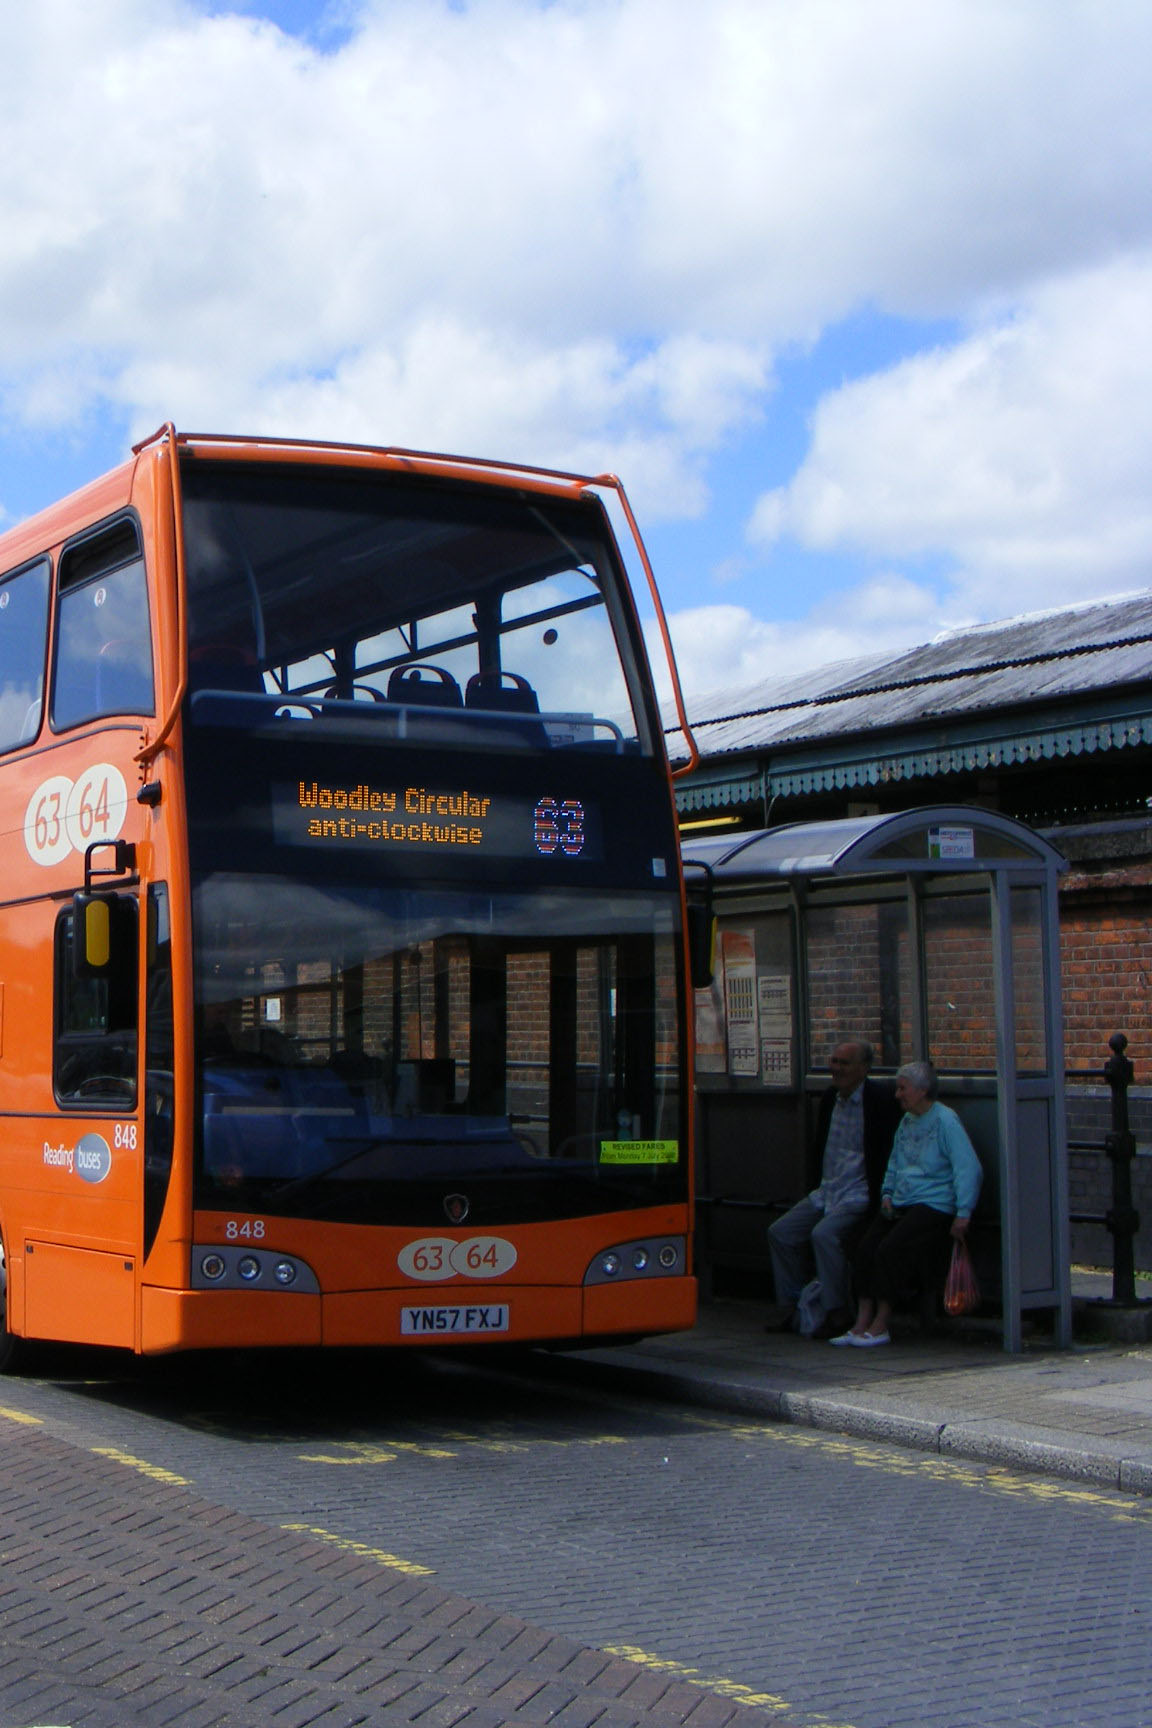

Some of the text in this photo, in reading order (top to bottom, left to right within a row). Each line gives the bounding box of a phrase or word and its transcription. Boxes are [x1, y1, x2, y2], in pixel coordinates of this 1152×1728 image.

[298, 781, 491, 817] Woodley Circular
[35, 776, 110, 851] 63 64
[534, 797, 585, 854] 63
[307, 818, 483, 844] anti-clockwise
[114, 1124, 138, 1150] 848
[43, 1142, 101, 1173] Reading buses
[225, 1221, 266, 1239] 848
[413, 1243, 498, 1271] 63 64
[409, 1307, 503, 1330] YN57 FXJ
